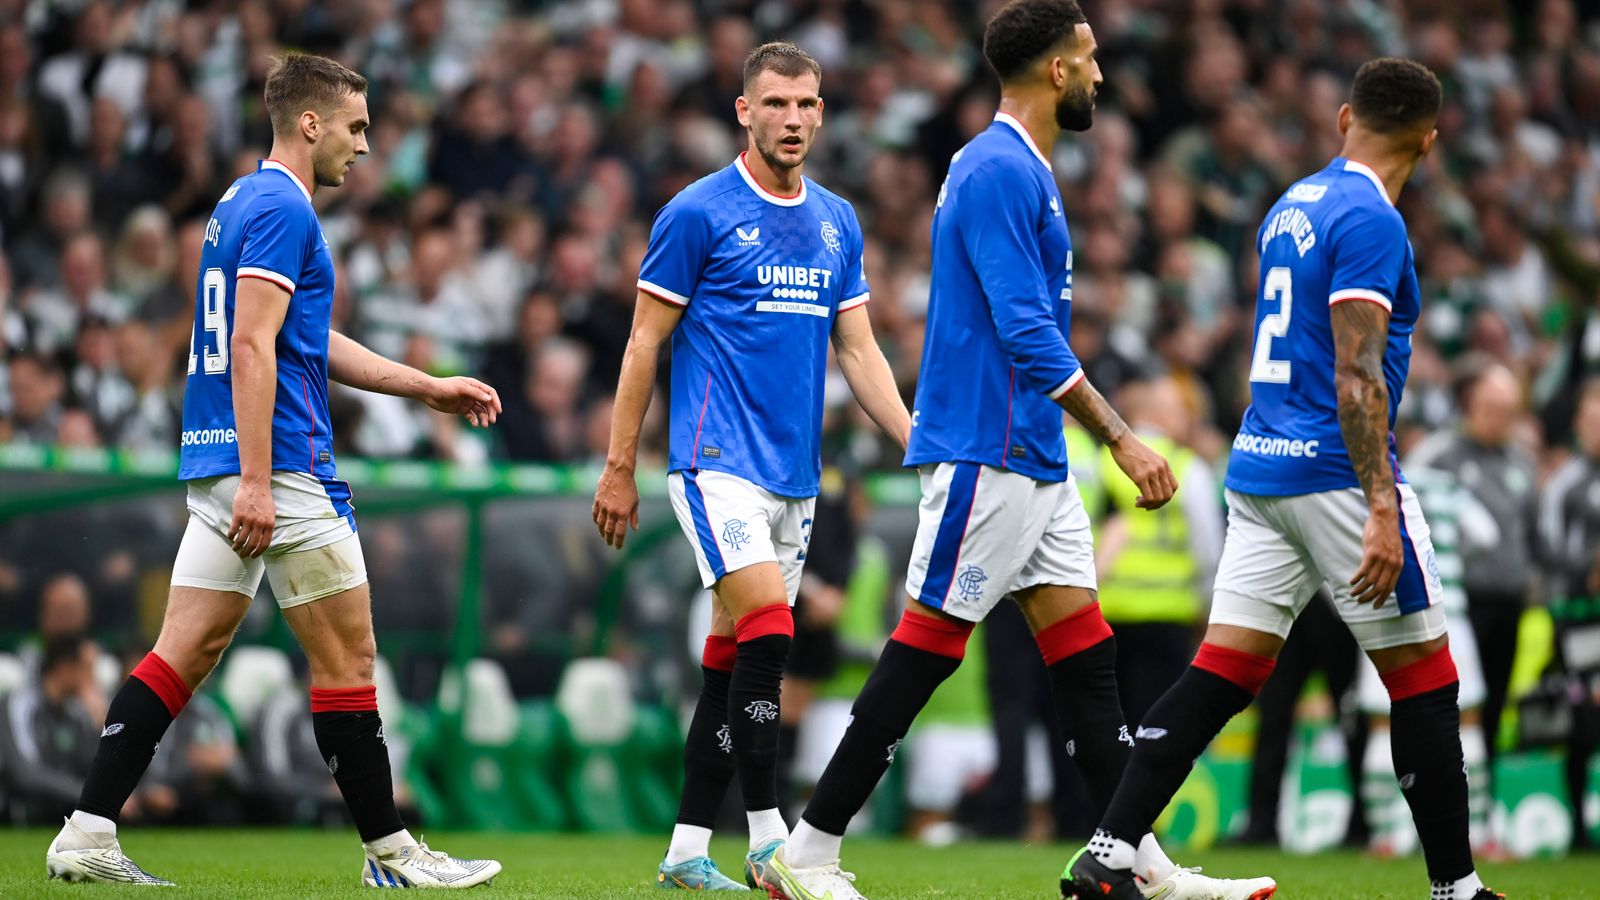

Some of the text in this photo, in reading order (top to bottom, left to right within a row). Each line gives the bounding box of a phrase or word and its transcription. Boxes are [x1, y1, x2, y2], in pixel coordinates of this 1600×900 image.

[1261, 206, 1316, 258] AVERNIER
[757, 265, 832, 288] UNIBET
[1249, 266, 1293, 384] 2
[1235, 433, 1320, 458] socomec
